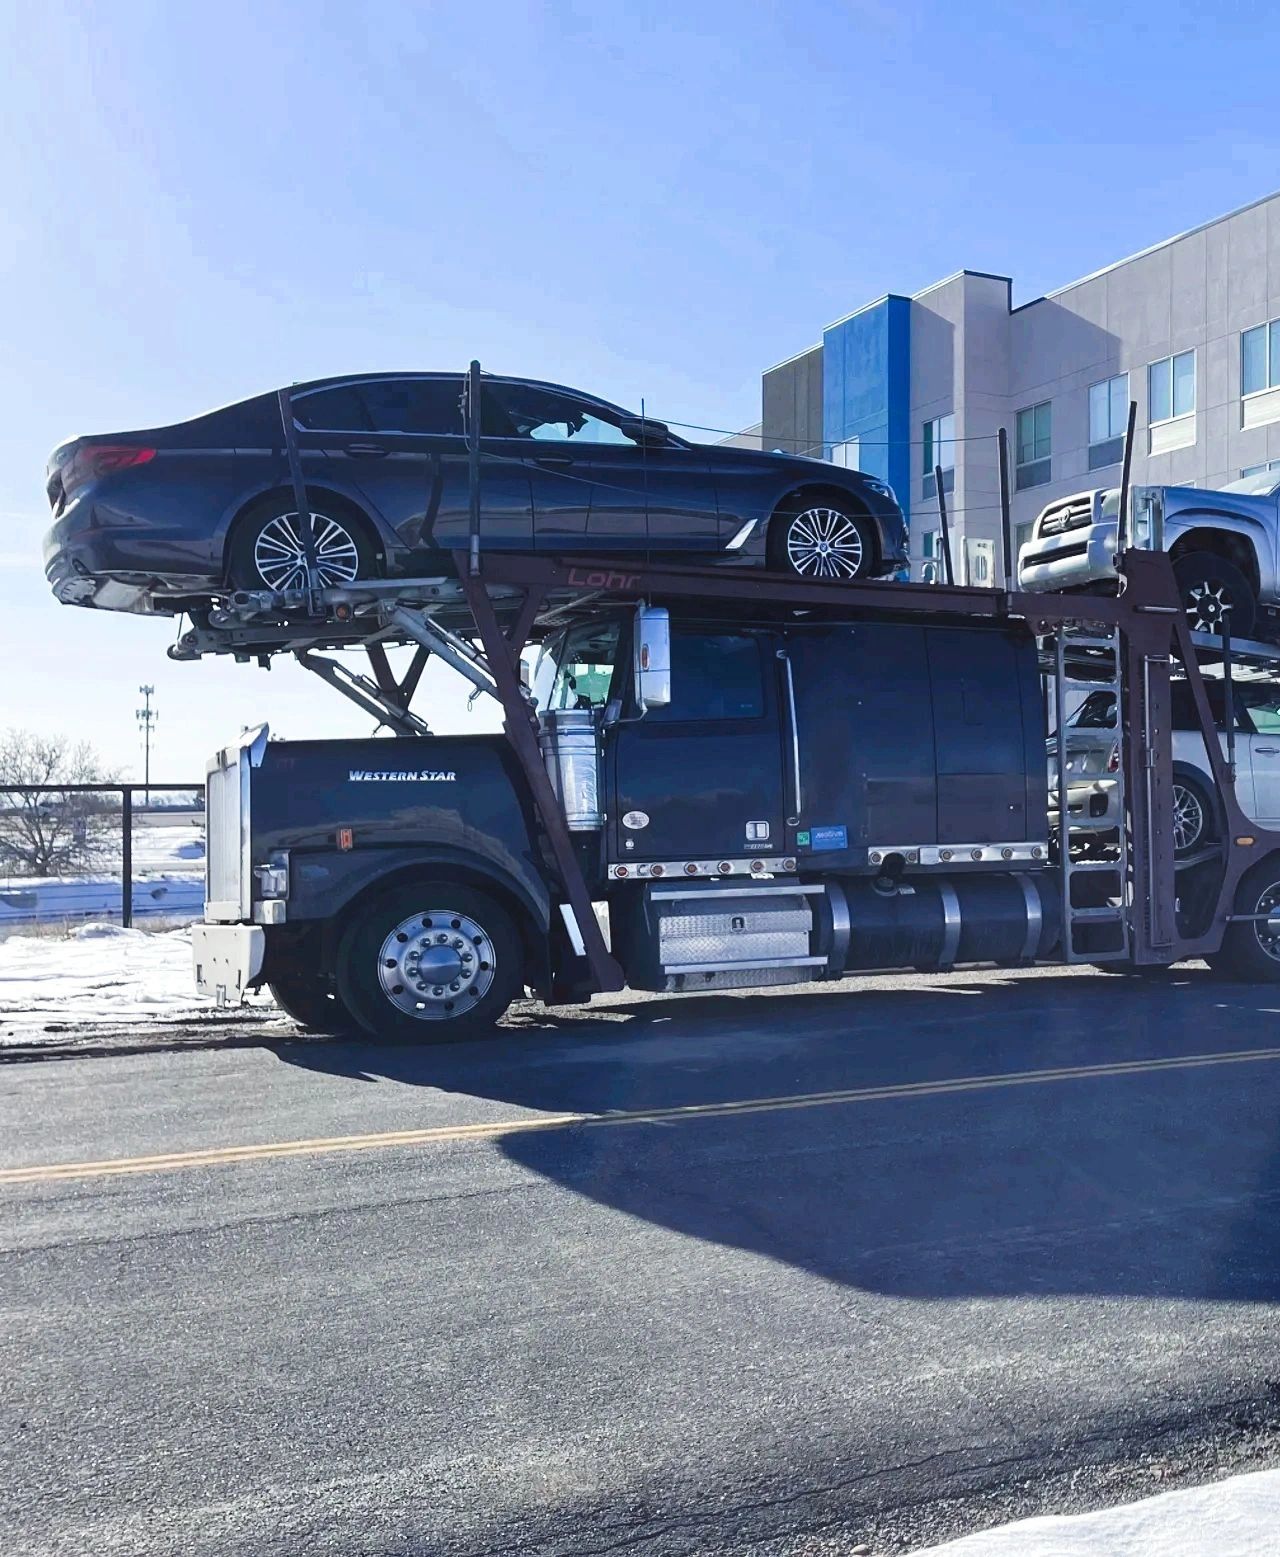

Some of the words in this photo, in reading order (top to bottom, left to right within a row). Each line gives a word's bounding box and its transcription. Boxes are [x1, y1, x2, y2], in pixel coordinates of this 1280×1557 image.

[568, 568, 641, 589] Lohr
[349, 770, 418, 781] WESTERN
[419, 770, 456, 781] STAR
